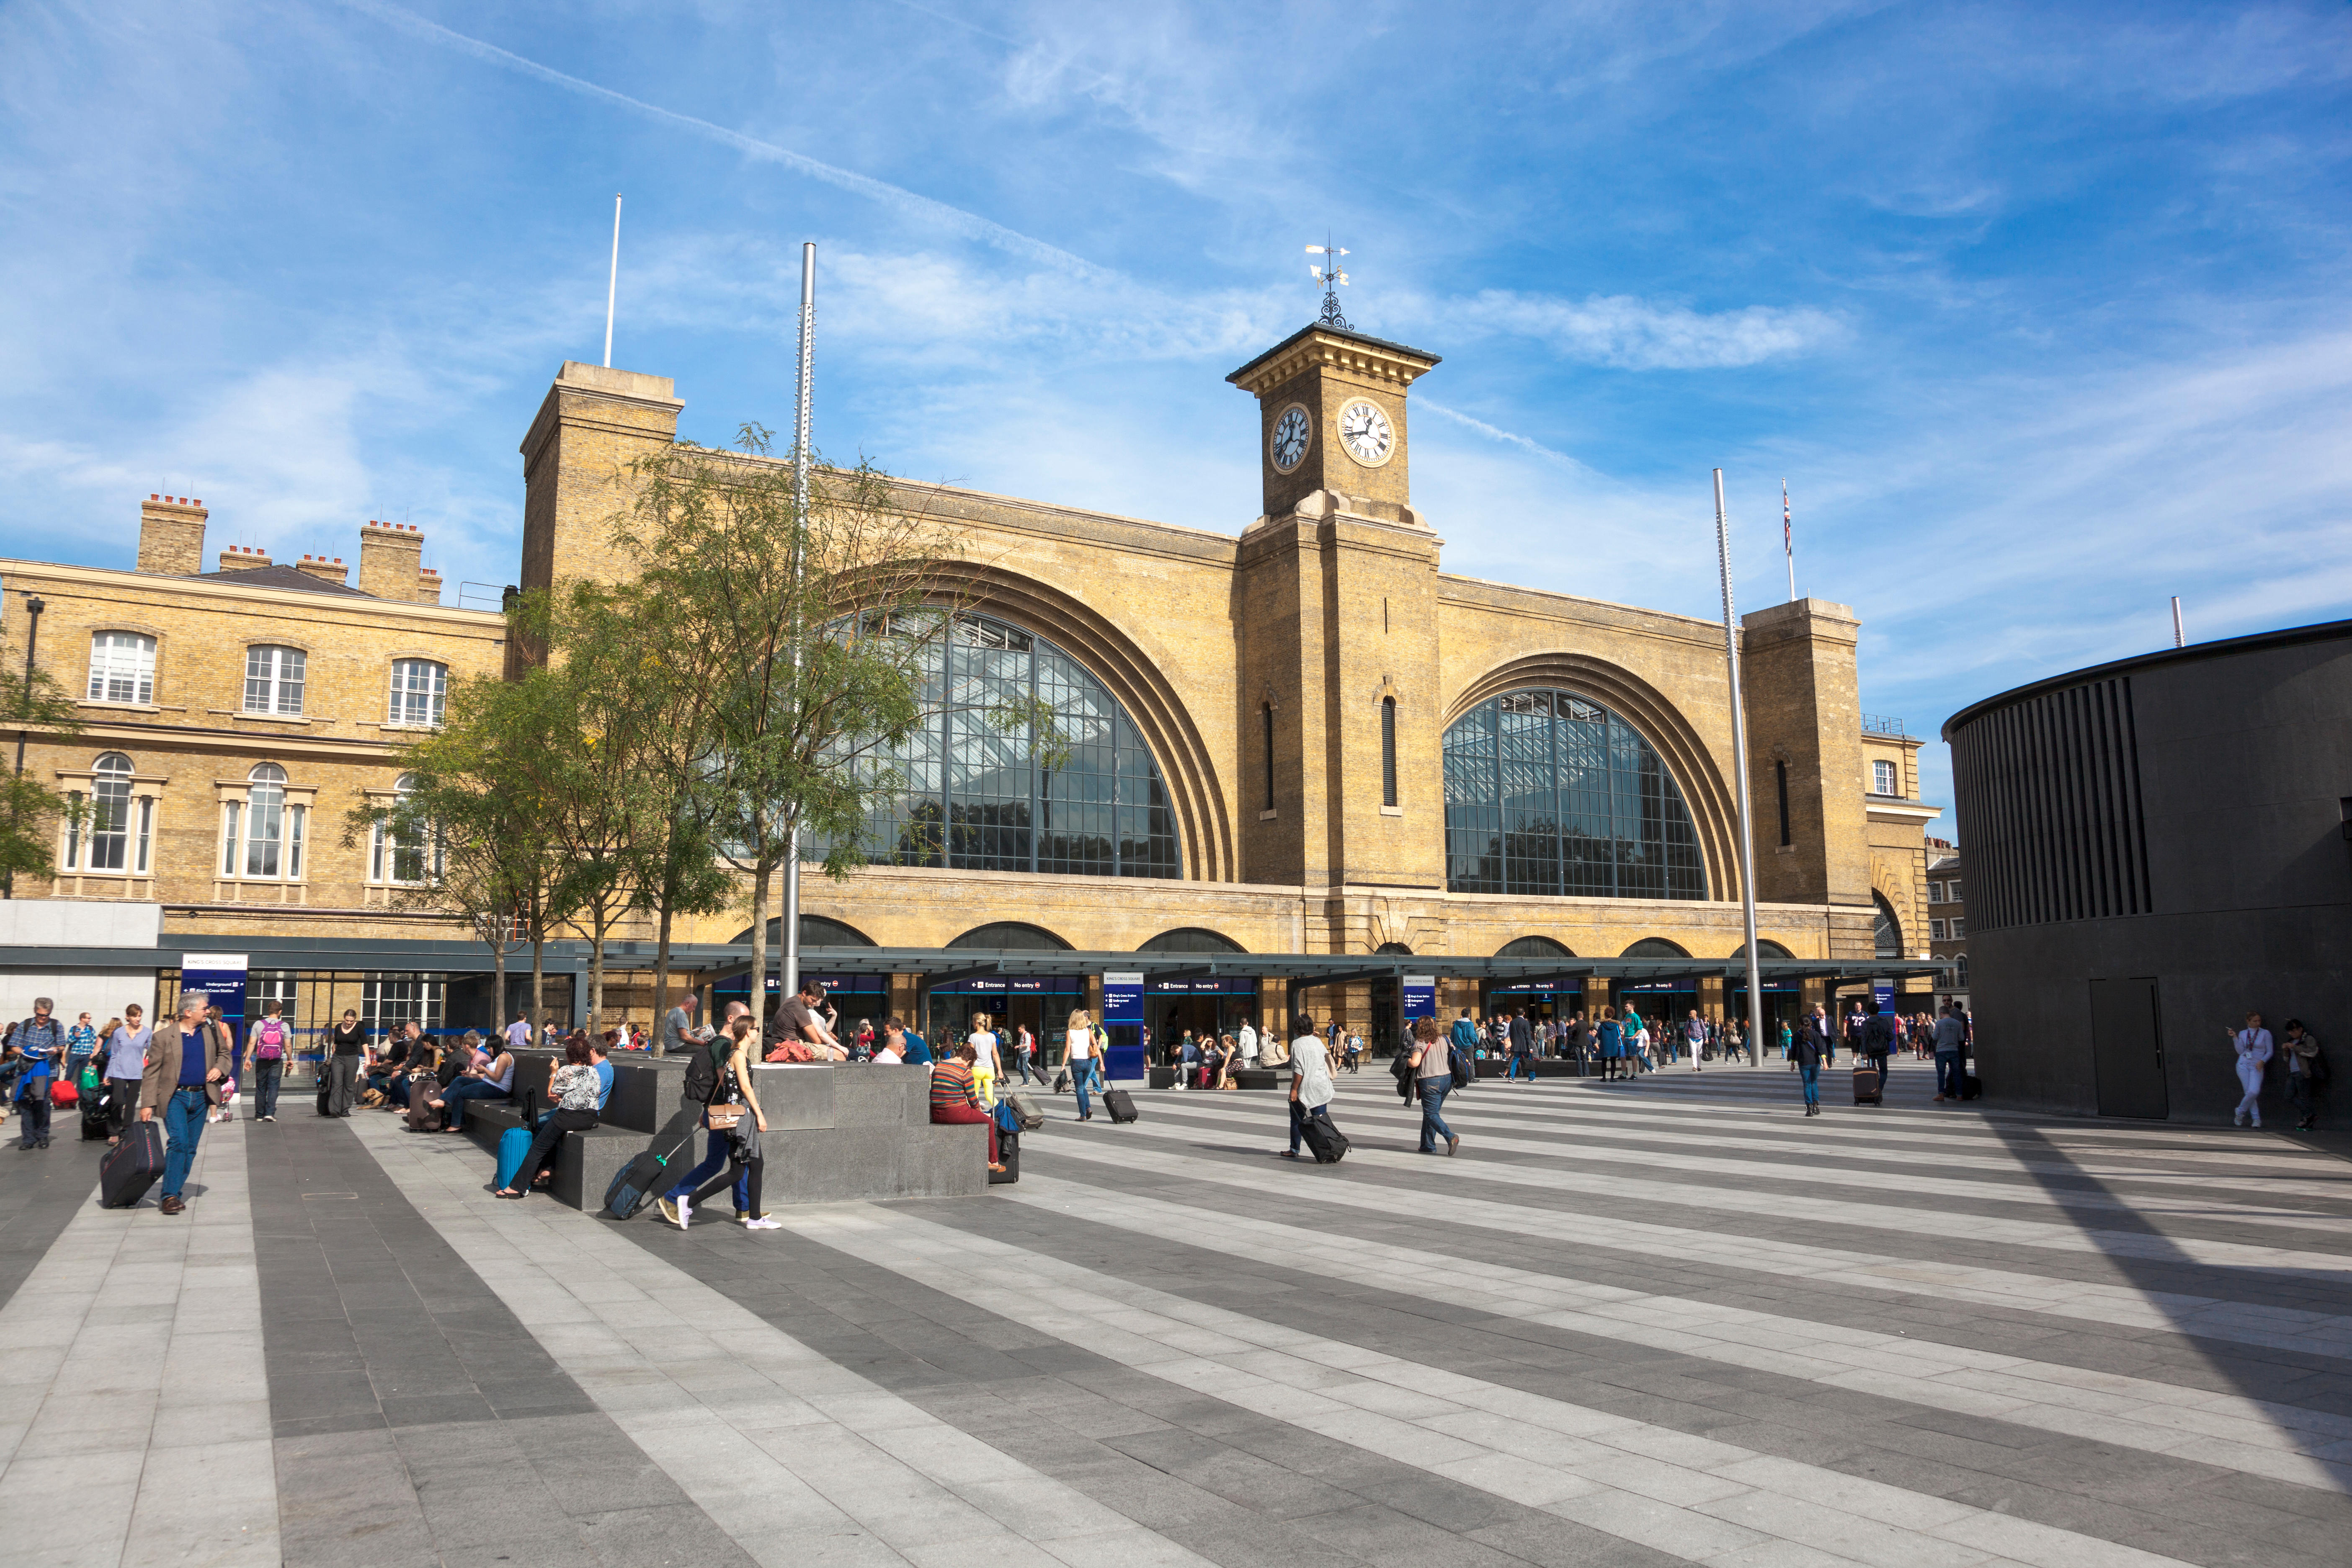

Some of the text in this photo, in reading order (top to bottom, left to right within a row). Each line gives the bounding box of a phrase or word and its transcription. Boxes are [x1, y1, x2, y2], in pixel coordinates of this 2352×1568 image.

[1310, 265, 1321, 278] W
[1337, 265, 1342, 276] S
[1317, 276, 1323, 289] N
[1340, 273, 1349, 286] E
[1353, 407, 1360, 417] XI
